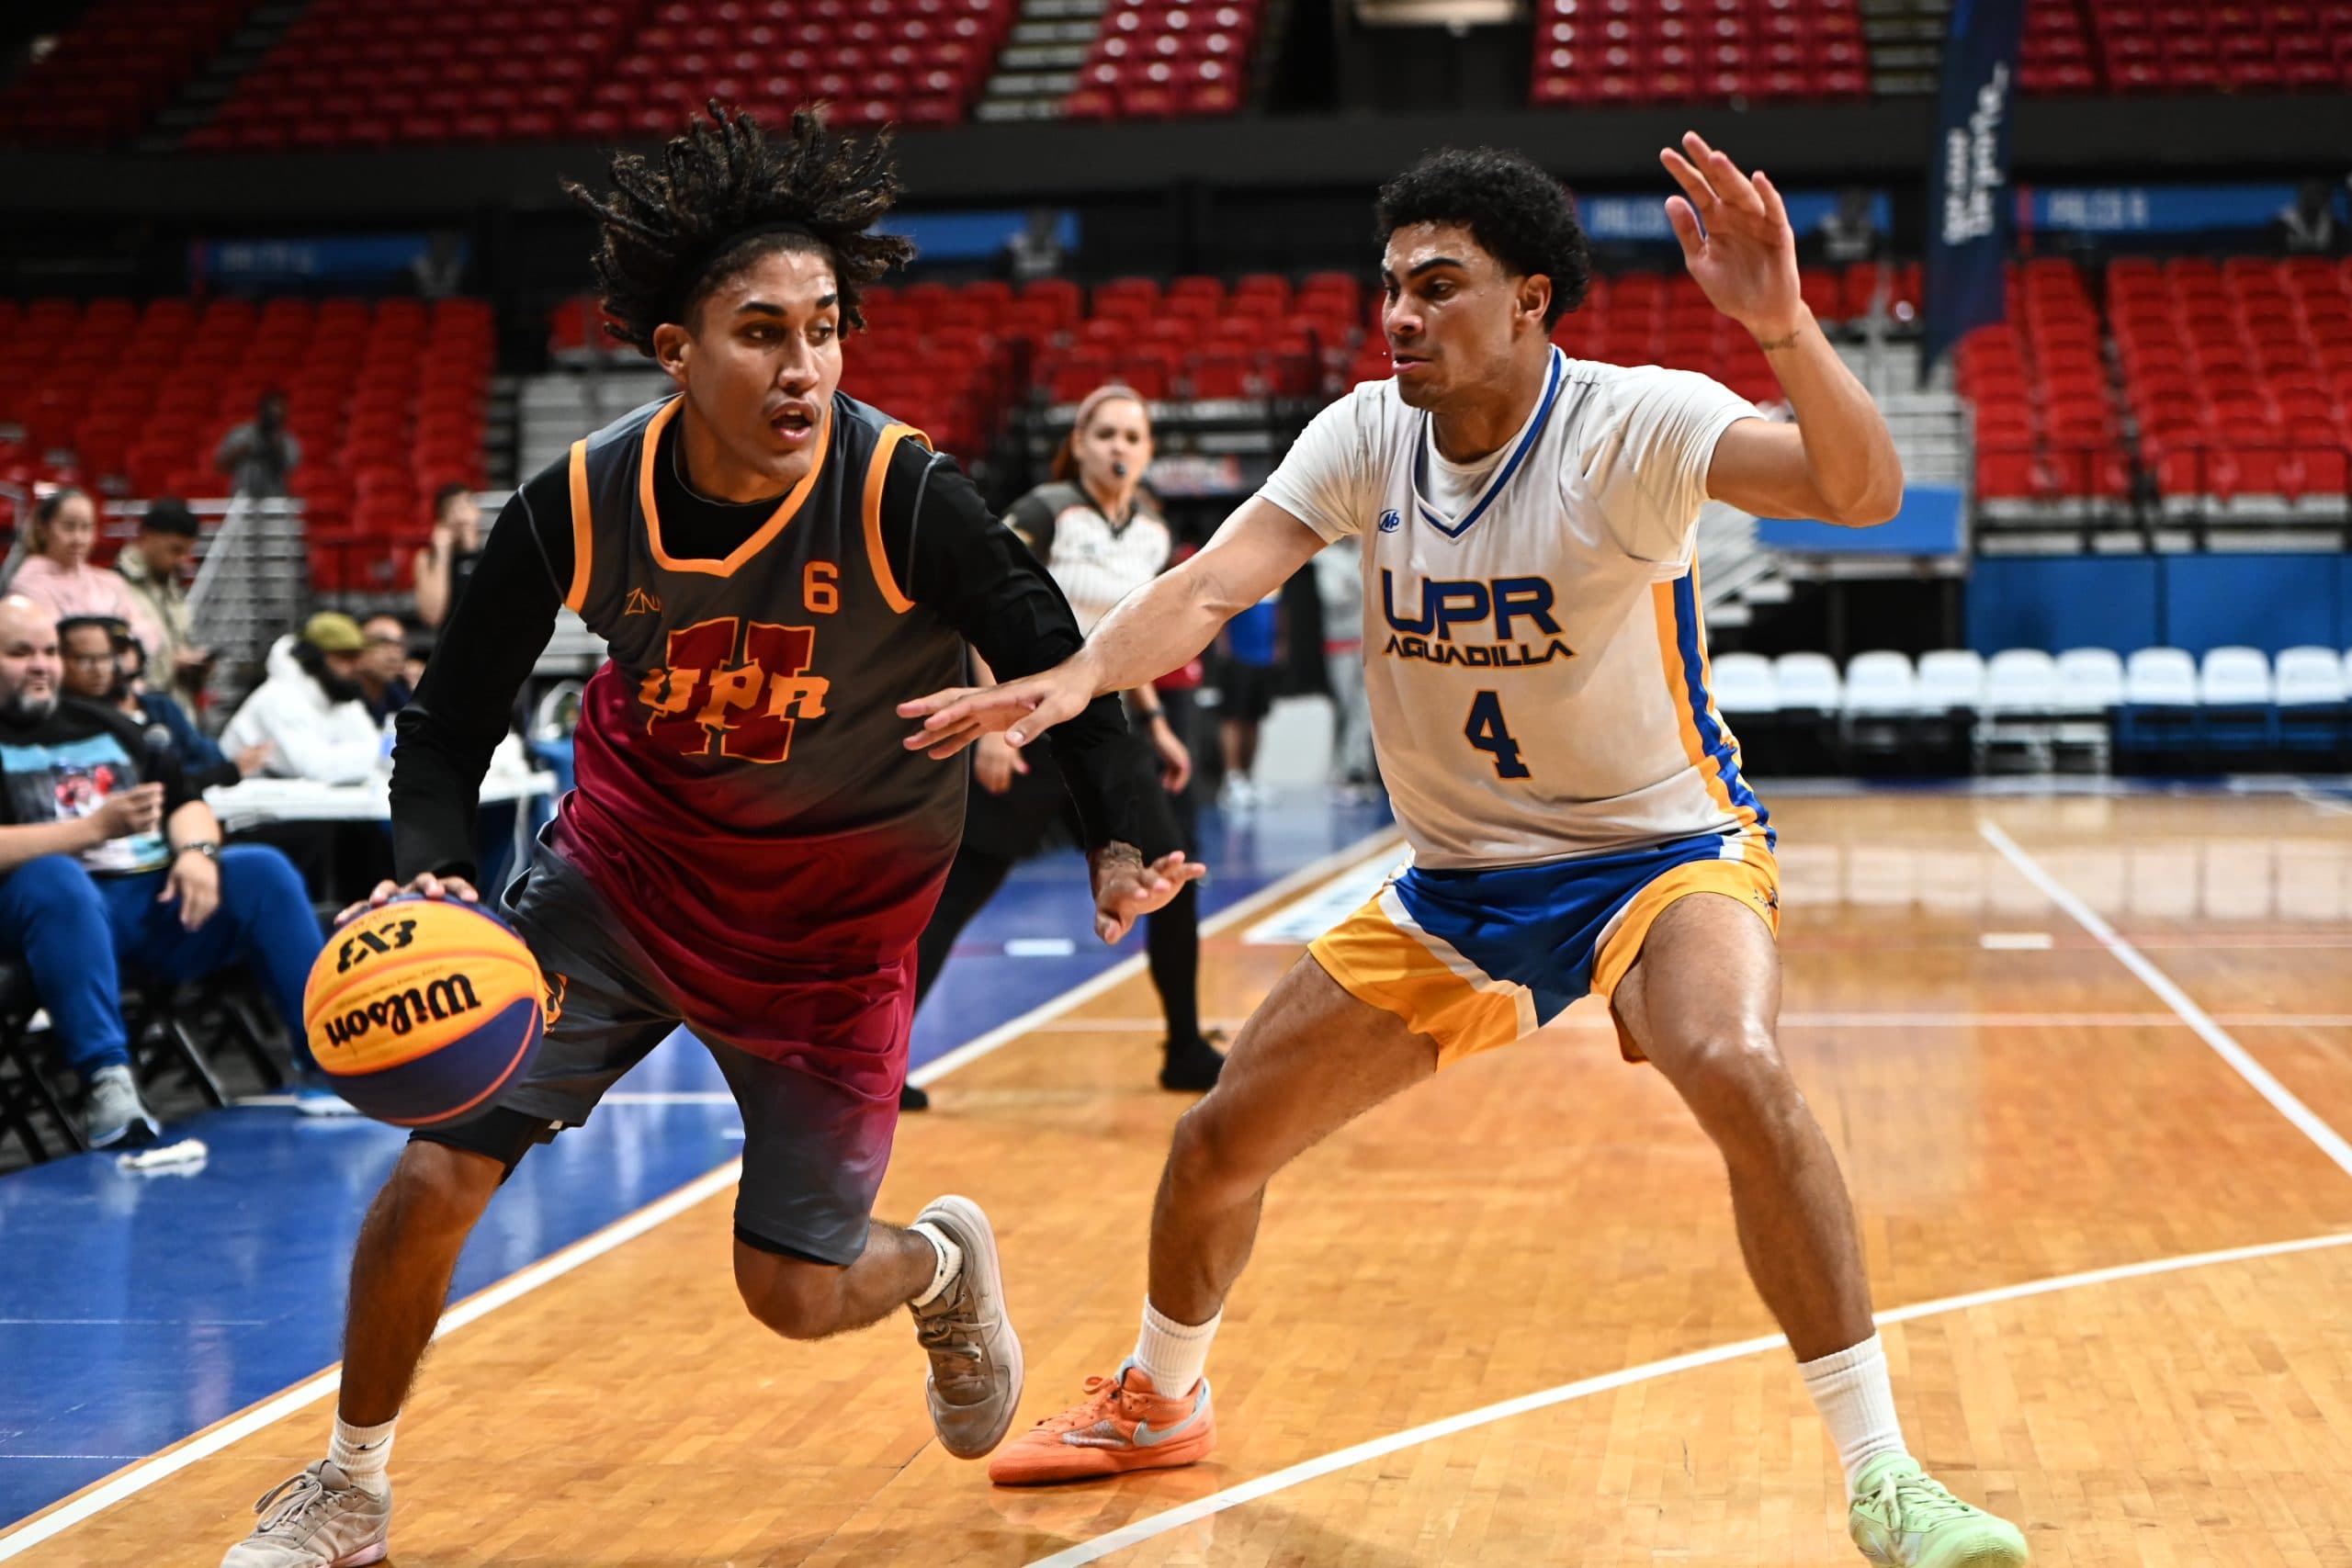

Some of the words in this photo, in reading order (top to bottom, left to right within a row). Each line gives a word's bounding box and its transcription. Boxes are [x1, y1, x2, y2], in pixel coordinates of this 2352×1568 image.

[803, 560, 839, 615] 6
[1380, 567, 1566, 641] UPR
[1382, 634, 1577, 668] AGUADILLA
[639, 658, 831, 731] UPR
[1463, 690, 1532, 780] 4
[323, 973, 482, 1048] Wilson
